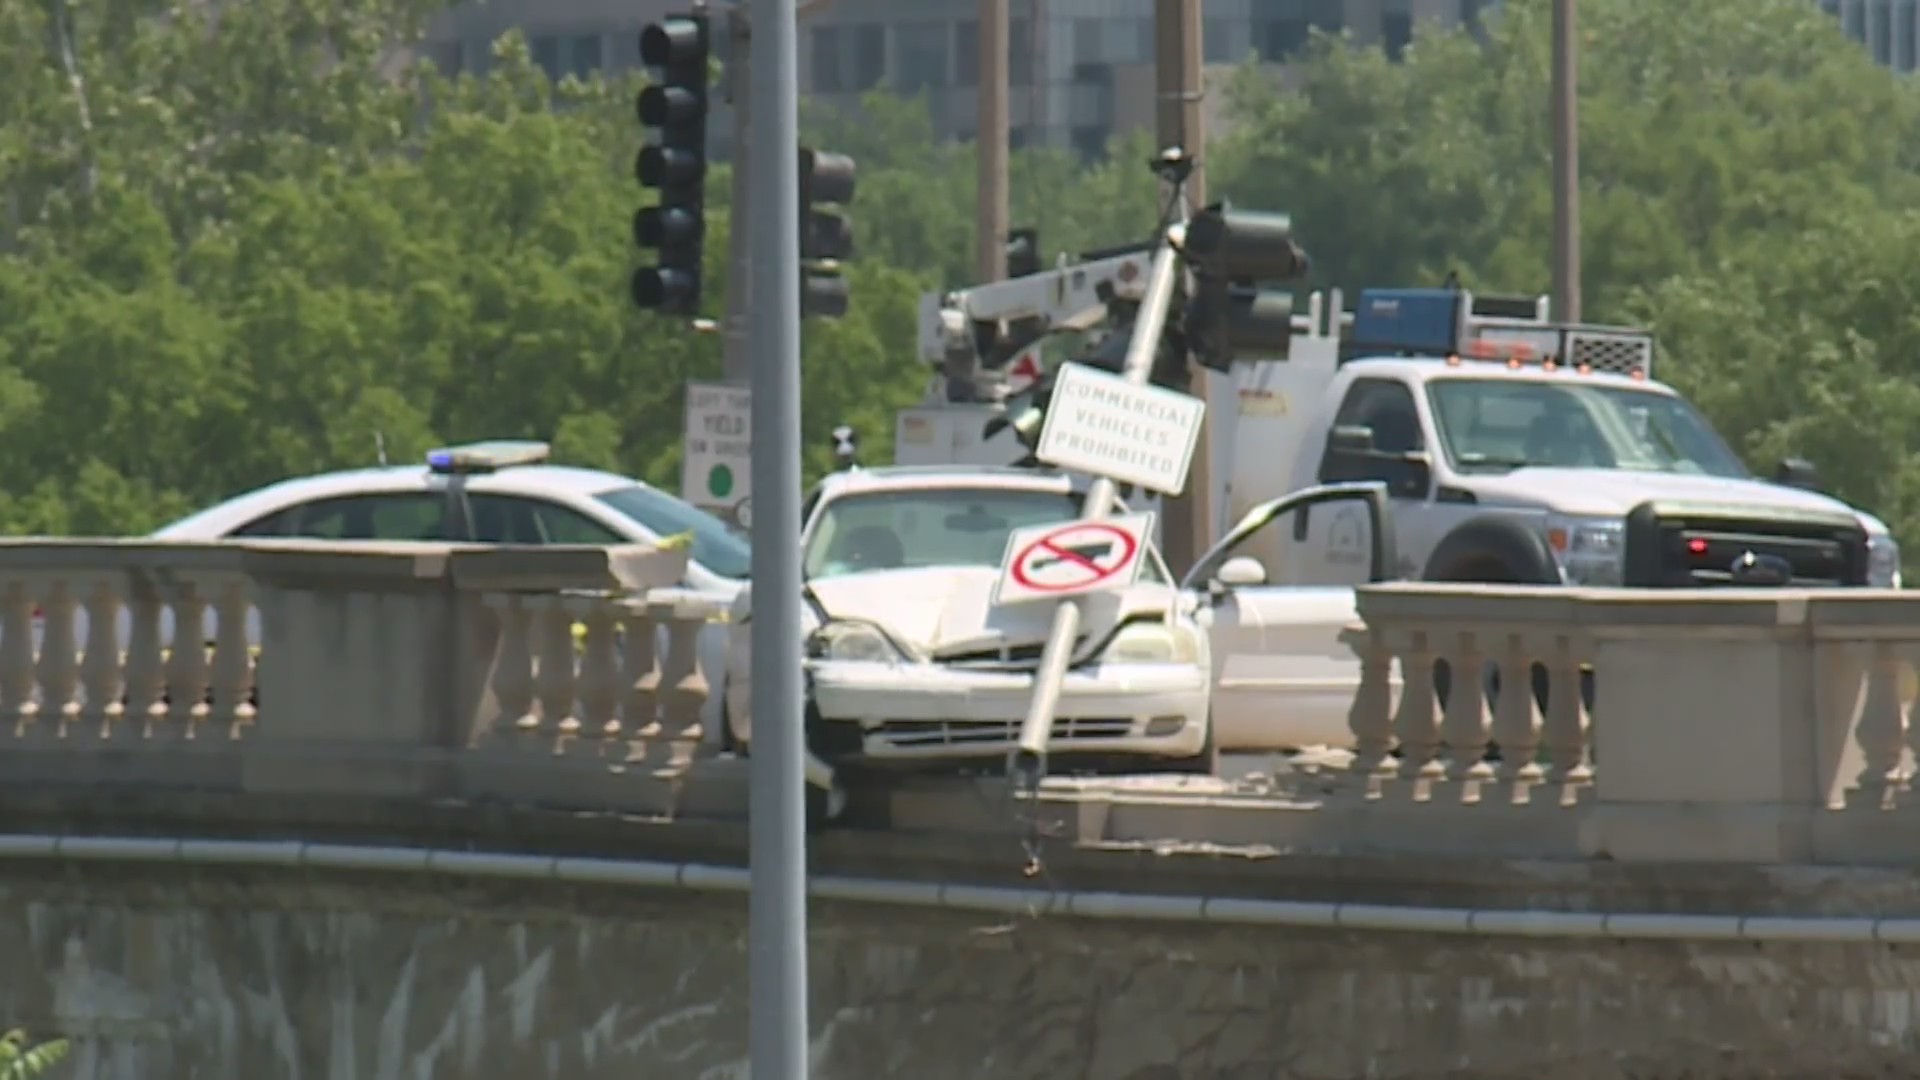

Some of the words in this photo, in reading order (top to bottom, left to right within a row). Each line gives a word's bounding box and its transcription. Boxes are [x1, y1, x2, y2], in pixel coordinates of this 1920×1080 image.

[1065, 381, 1187, 427] COMMERCIAL
[703, 414, 746, 435] YIELD
[1076, 408, 1169, 446] VEHICLES
[1056, 431, 1173, 474] PROHIBITED
